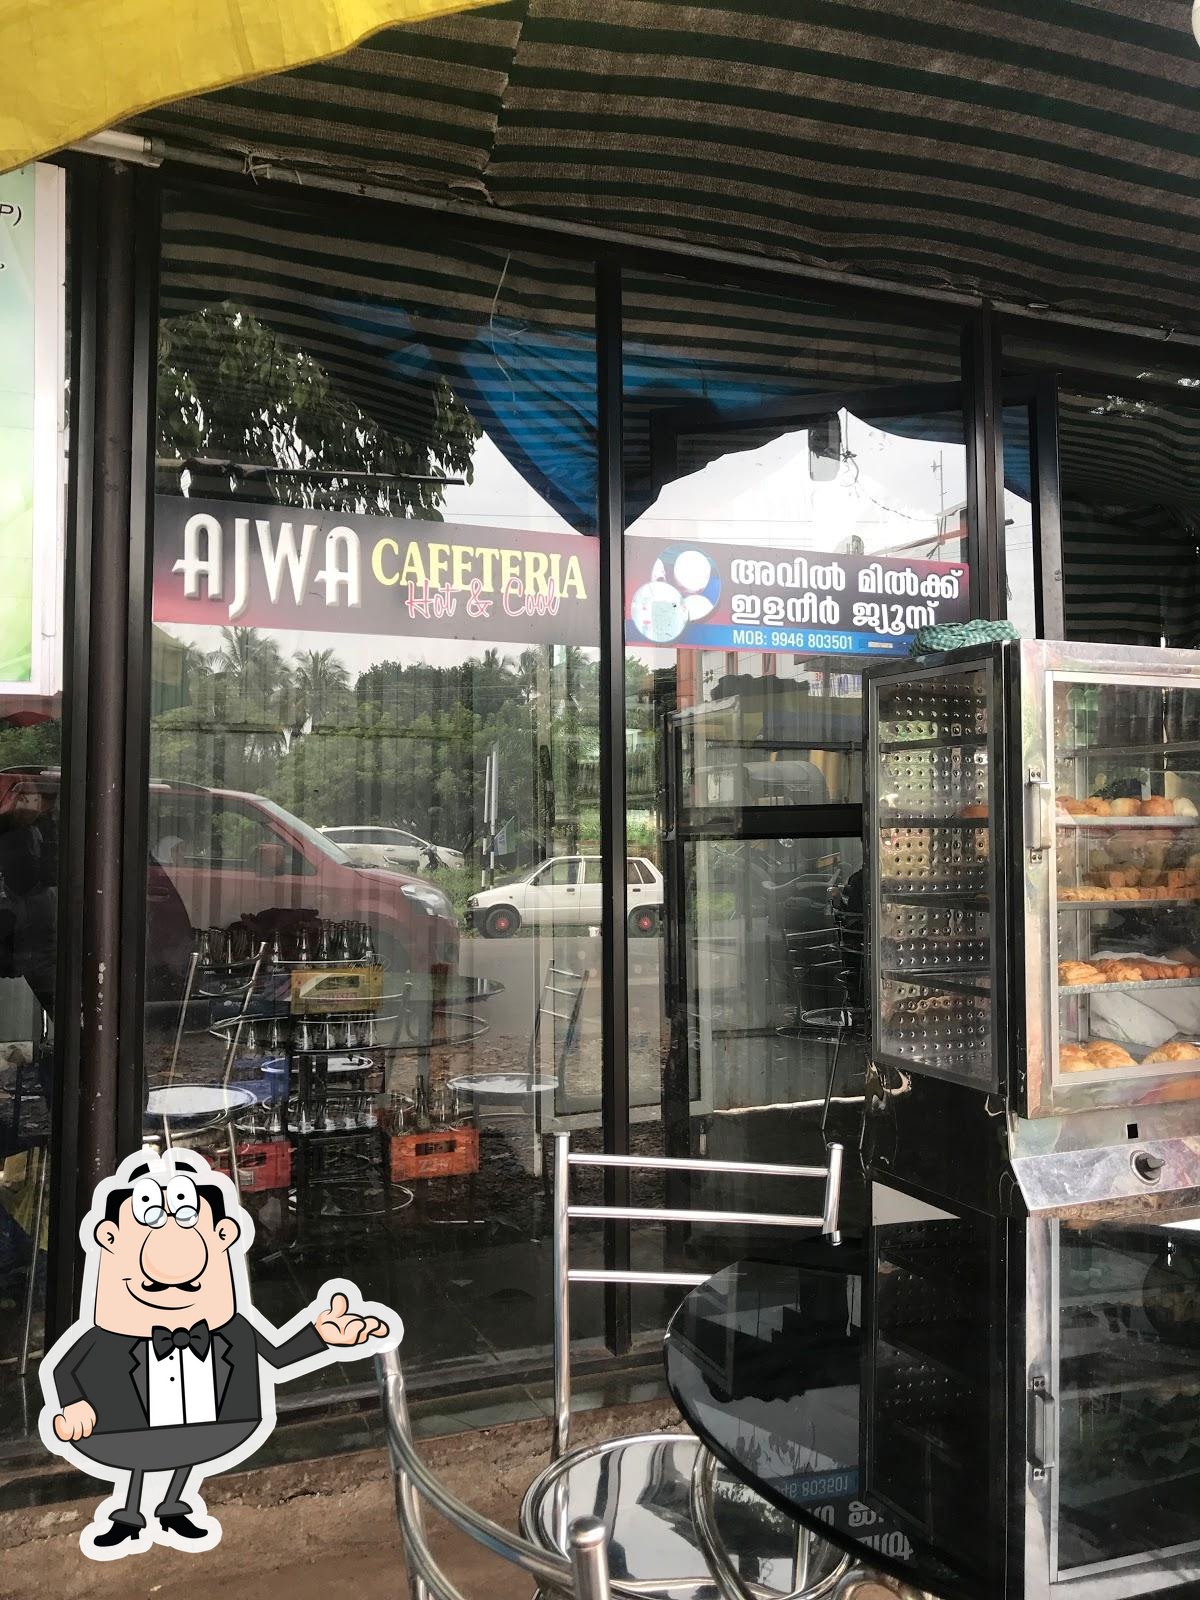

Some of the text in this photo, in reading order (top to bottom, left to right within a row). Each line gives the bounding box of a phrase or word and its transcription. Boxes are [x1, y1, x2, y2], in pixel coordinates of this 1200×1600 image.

[172, 513, 588, 621] AJWA CAFETERIA
[730, 557, 963, 599] അവിൽ മിൽക്ക്
[405, 576, 562, 619] Hot & Cool
[731, 591, 840, 627] ഇളനീർ
[732, 629, 853, 651] MOB: 9946 803501
